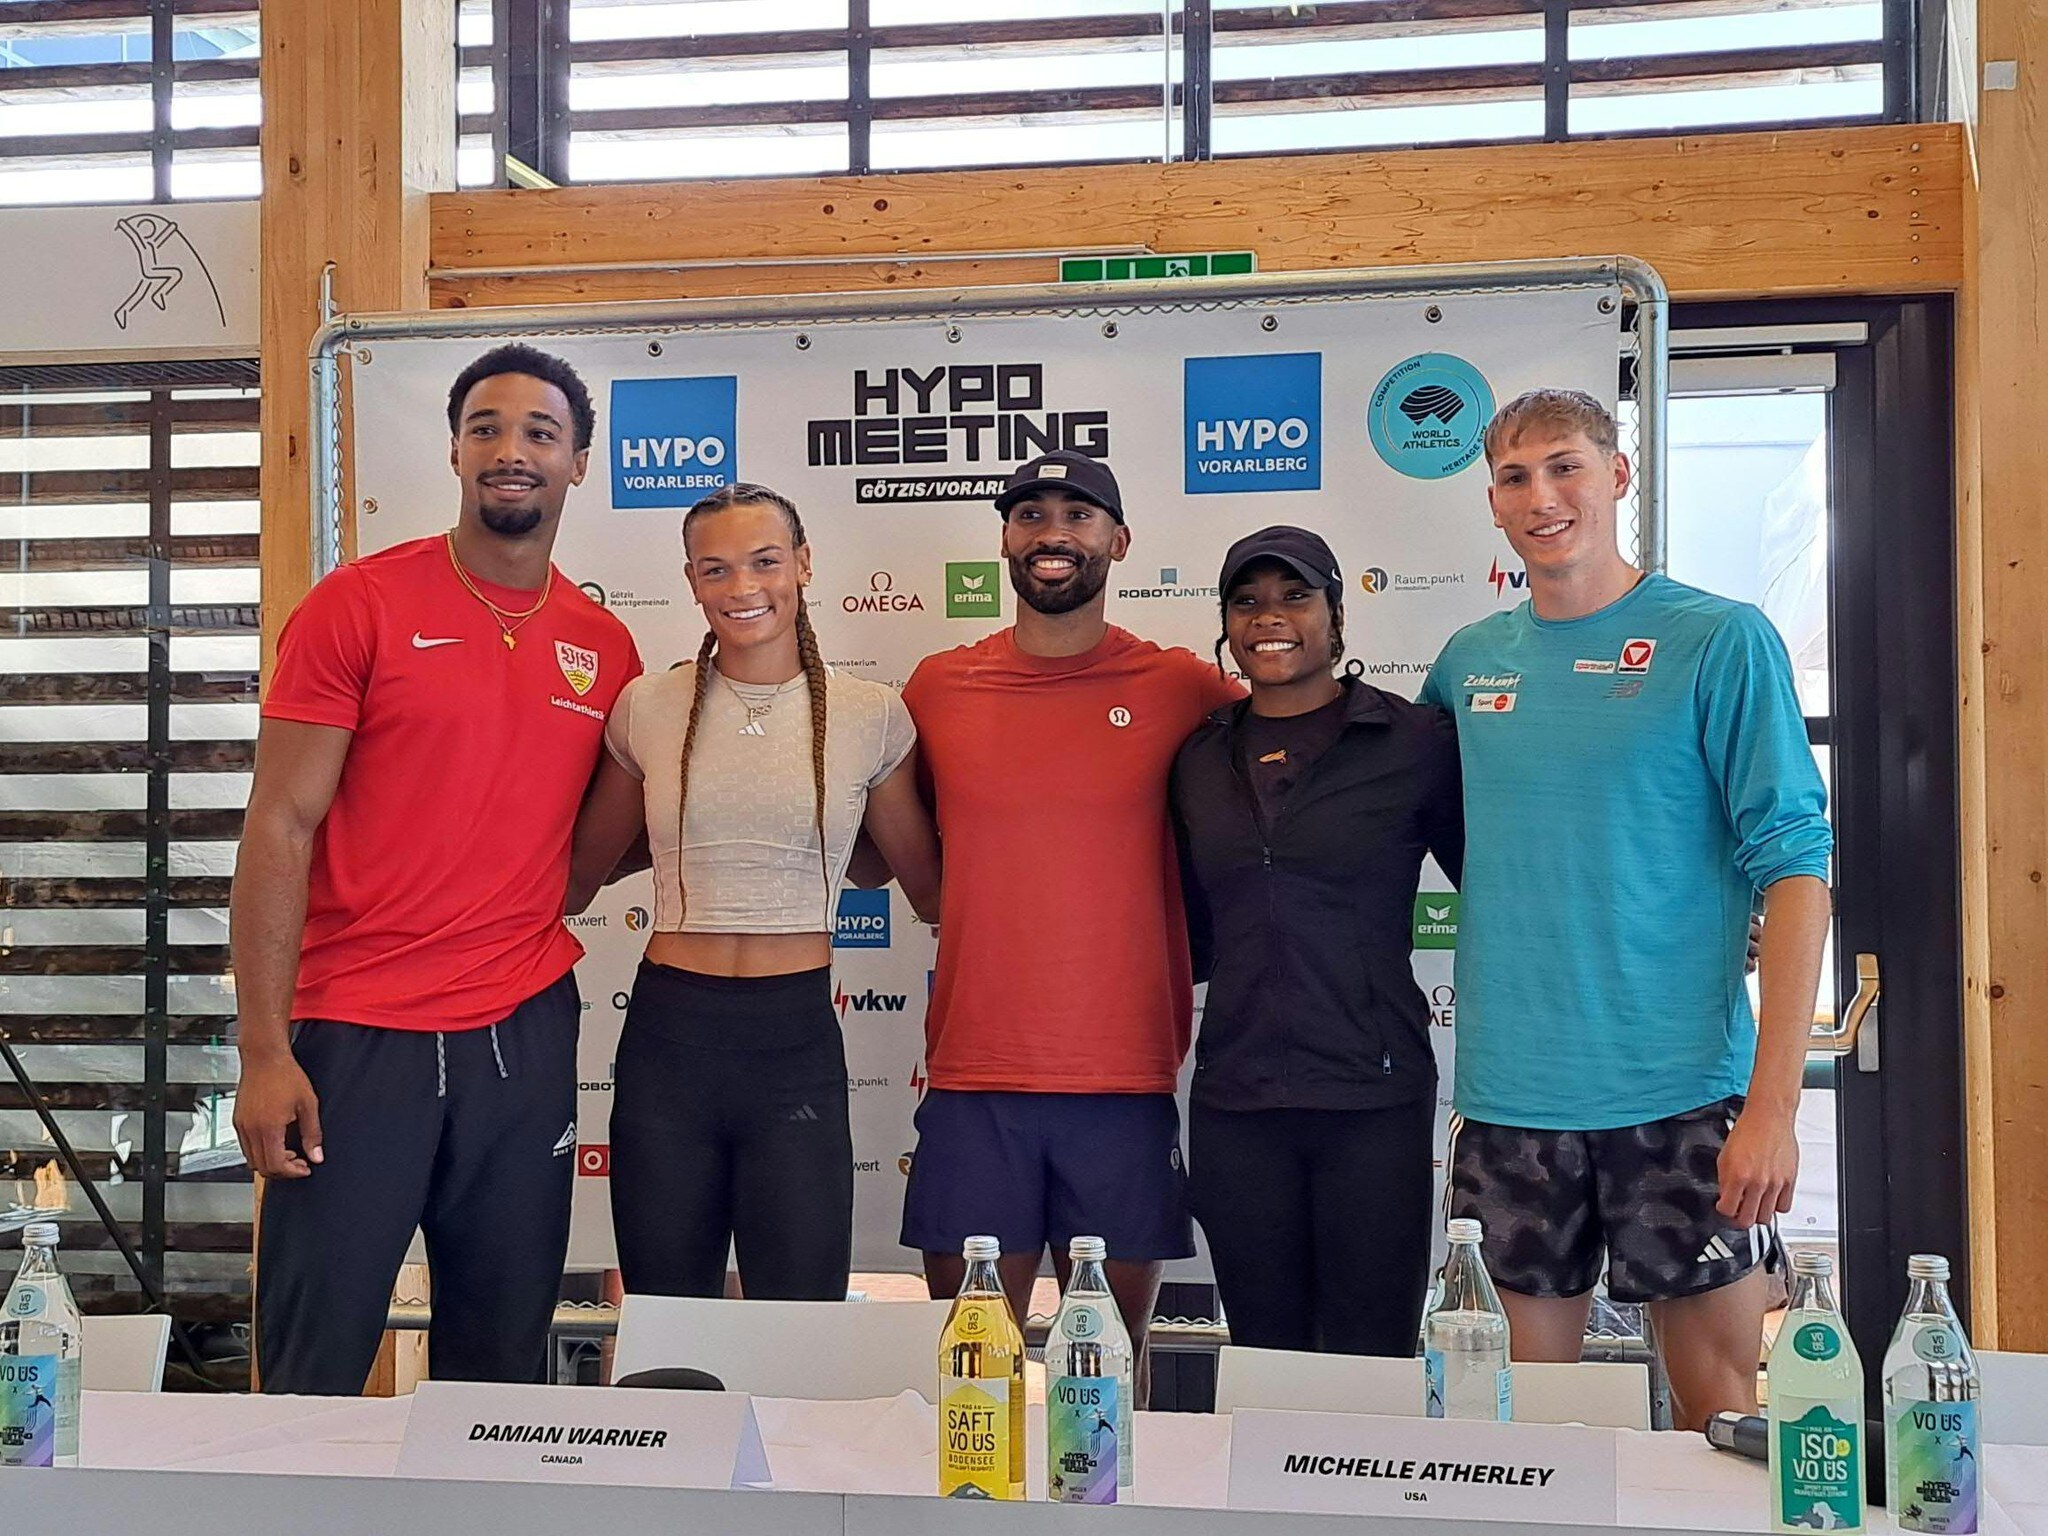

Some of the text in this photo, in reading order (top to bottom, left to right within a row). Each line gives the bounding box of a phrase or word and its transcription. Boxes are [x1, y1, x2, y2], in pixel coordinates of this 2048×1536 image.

[855, 363, 1043, 416] HYPO
[1375, 361, 1421, 408] COMPETITION
[807, 411, 1108, 466] MEETING
[1197, 417, 1309, 452] HYPO
[1412, 429, 1451, 439] WORLD
[621, 436, 725, 469] HYPO
[1402, 438, 1460, 450] ATHLETICS
[1198, 457, 1308, 474] VORARLBERG
[1441, 443, 1480, 473] HERITAGE
[623, 474, 725, 490] VORARLBERG
[860, 477, 1009, 500] GÖTZIS/VORARL
[1394, 573, 1465, 585] Raum.punkt
[610, 590, 634, 598] Götzis
[954, 591, 992, 603] erima
[1118, 587, 1219, 599] ROBOTUNITS
[842, 593, 925, 613] OMEGA
[837, 916, 885, 930] HYPO
[1418, 923, 1458, 934] erima
[837, 932, 885, 940] VORARLBERG
[851, 989, 907, 1011] vkw
[1058, 1386, 1100, 1405] VO ÜS
[948, 1410, 995, 1432] SAFT
[1913, 1412, 1962, 1431] VO ÜS
[468, 1424, 668, 1448] DAMIAN WARNER
[948, 1431, 995, 1452] VO ÜS
[1801, 1433, 1839, 1460] ISO
[541, 1454, 583, 1465] CANADA
[948, 1454, 994, 1465] BODENSEE
[1283, 1454, 1554, 1486] MICHELLE ATHERLEY
[1793, 1459, 1848, 1481] VO ÜS
[1404, 1491, 1428, 1502] USA
